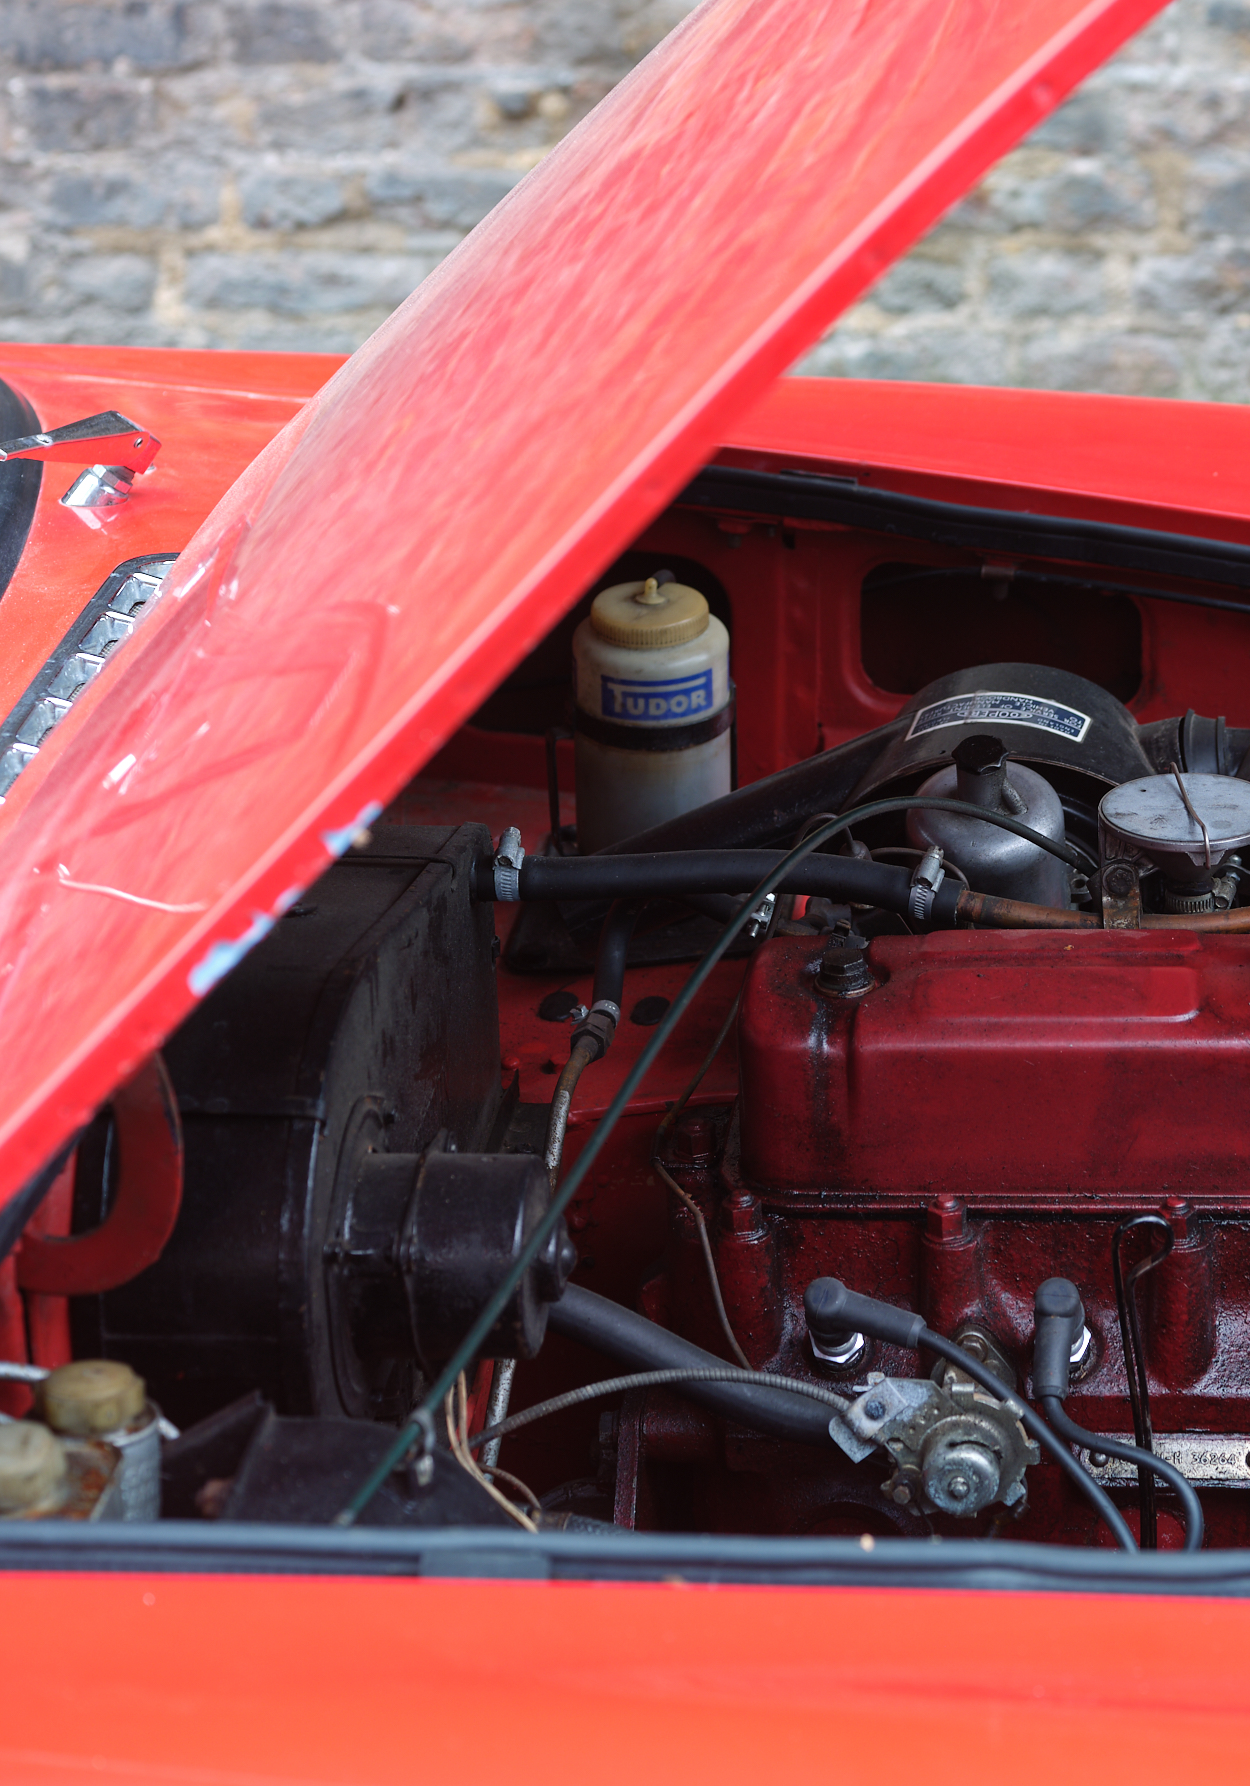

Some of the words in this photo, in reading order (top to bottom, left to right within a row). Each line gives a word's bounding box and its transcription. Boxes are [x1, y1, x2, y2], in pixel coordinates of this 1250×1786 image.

[607, 676, 707, 715] TUDOR
[975, 695, 1033, 704] HANDBOOK
[964, 710, 1031, 719] COOPER
[1014, 702, 1055, 715] VEHICLE
[1021, 706, 1059, 719] SERVICE
[1037, 718, 1075, 733] ENGLAND
[1069, 716, 1083, 725] TO
[1191, 1451, 1237, 1466] 36264
